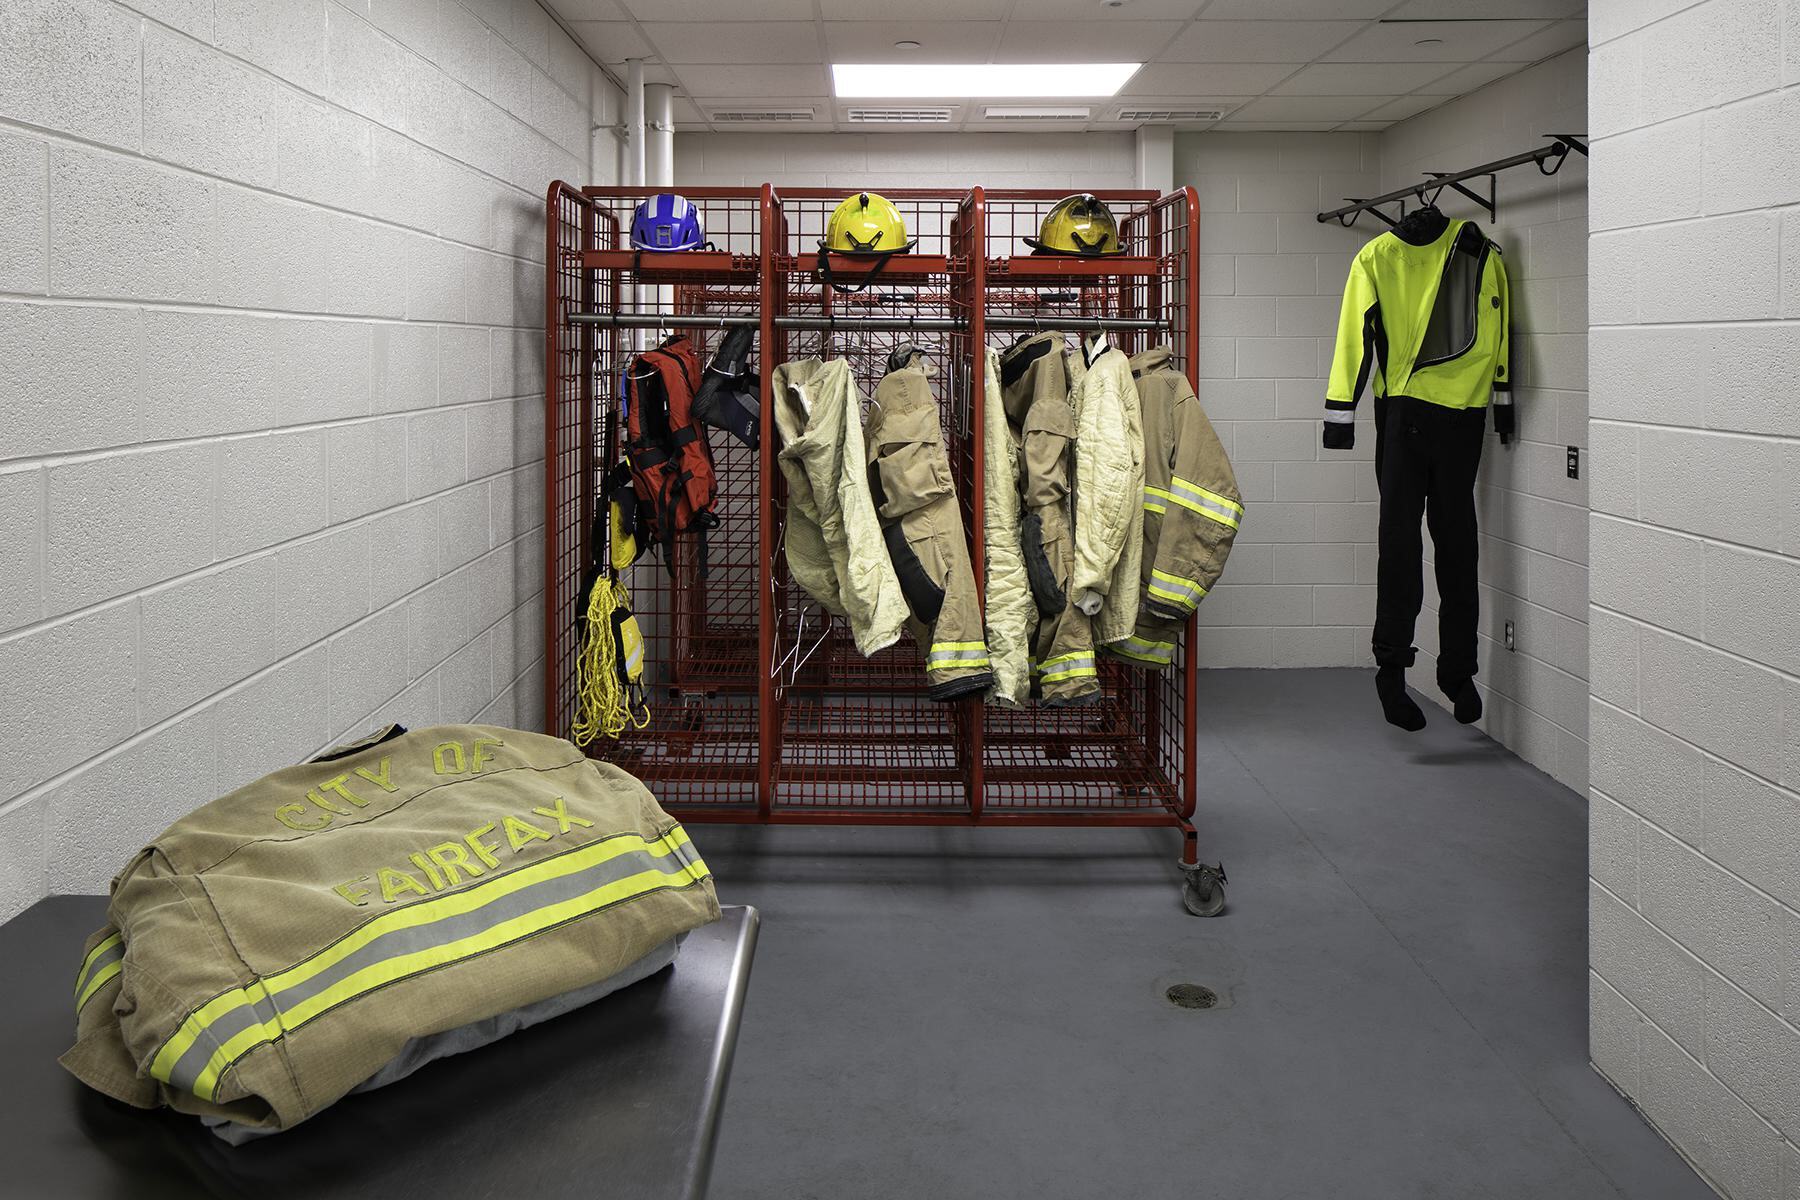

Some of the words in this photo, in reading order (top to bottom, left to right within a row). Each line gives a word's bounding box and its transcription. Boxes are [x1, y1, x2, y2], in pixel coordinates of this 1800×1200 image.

[274, 756, 400, 831] CITY
[432, 738, 503, 775] OF
[333, 796, 594, 906] FAIRFAX
